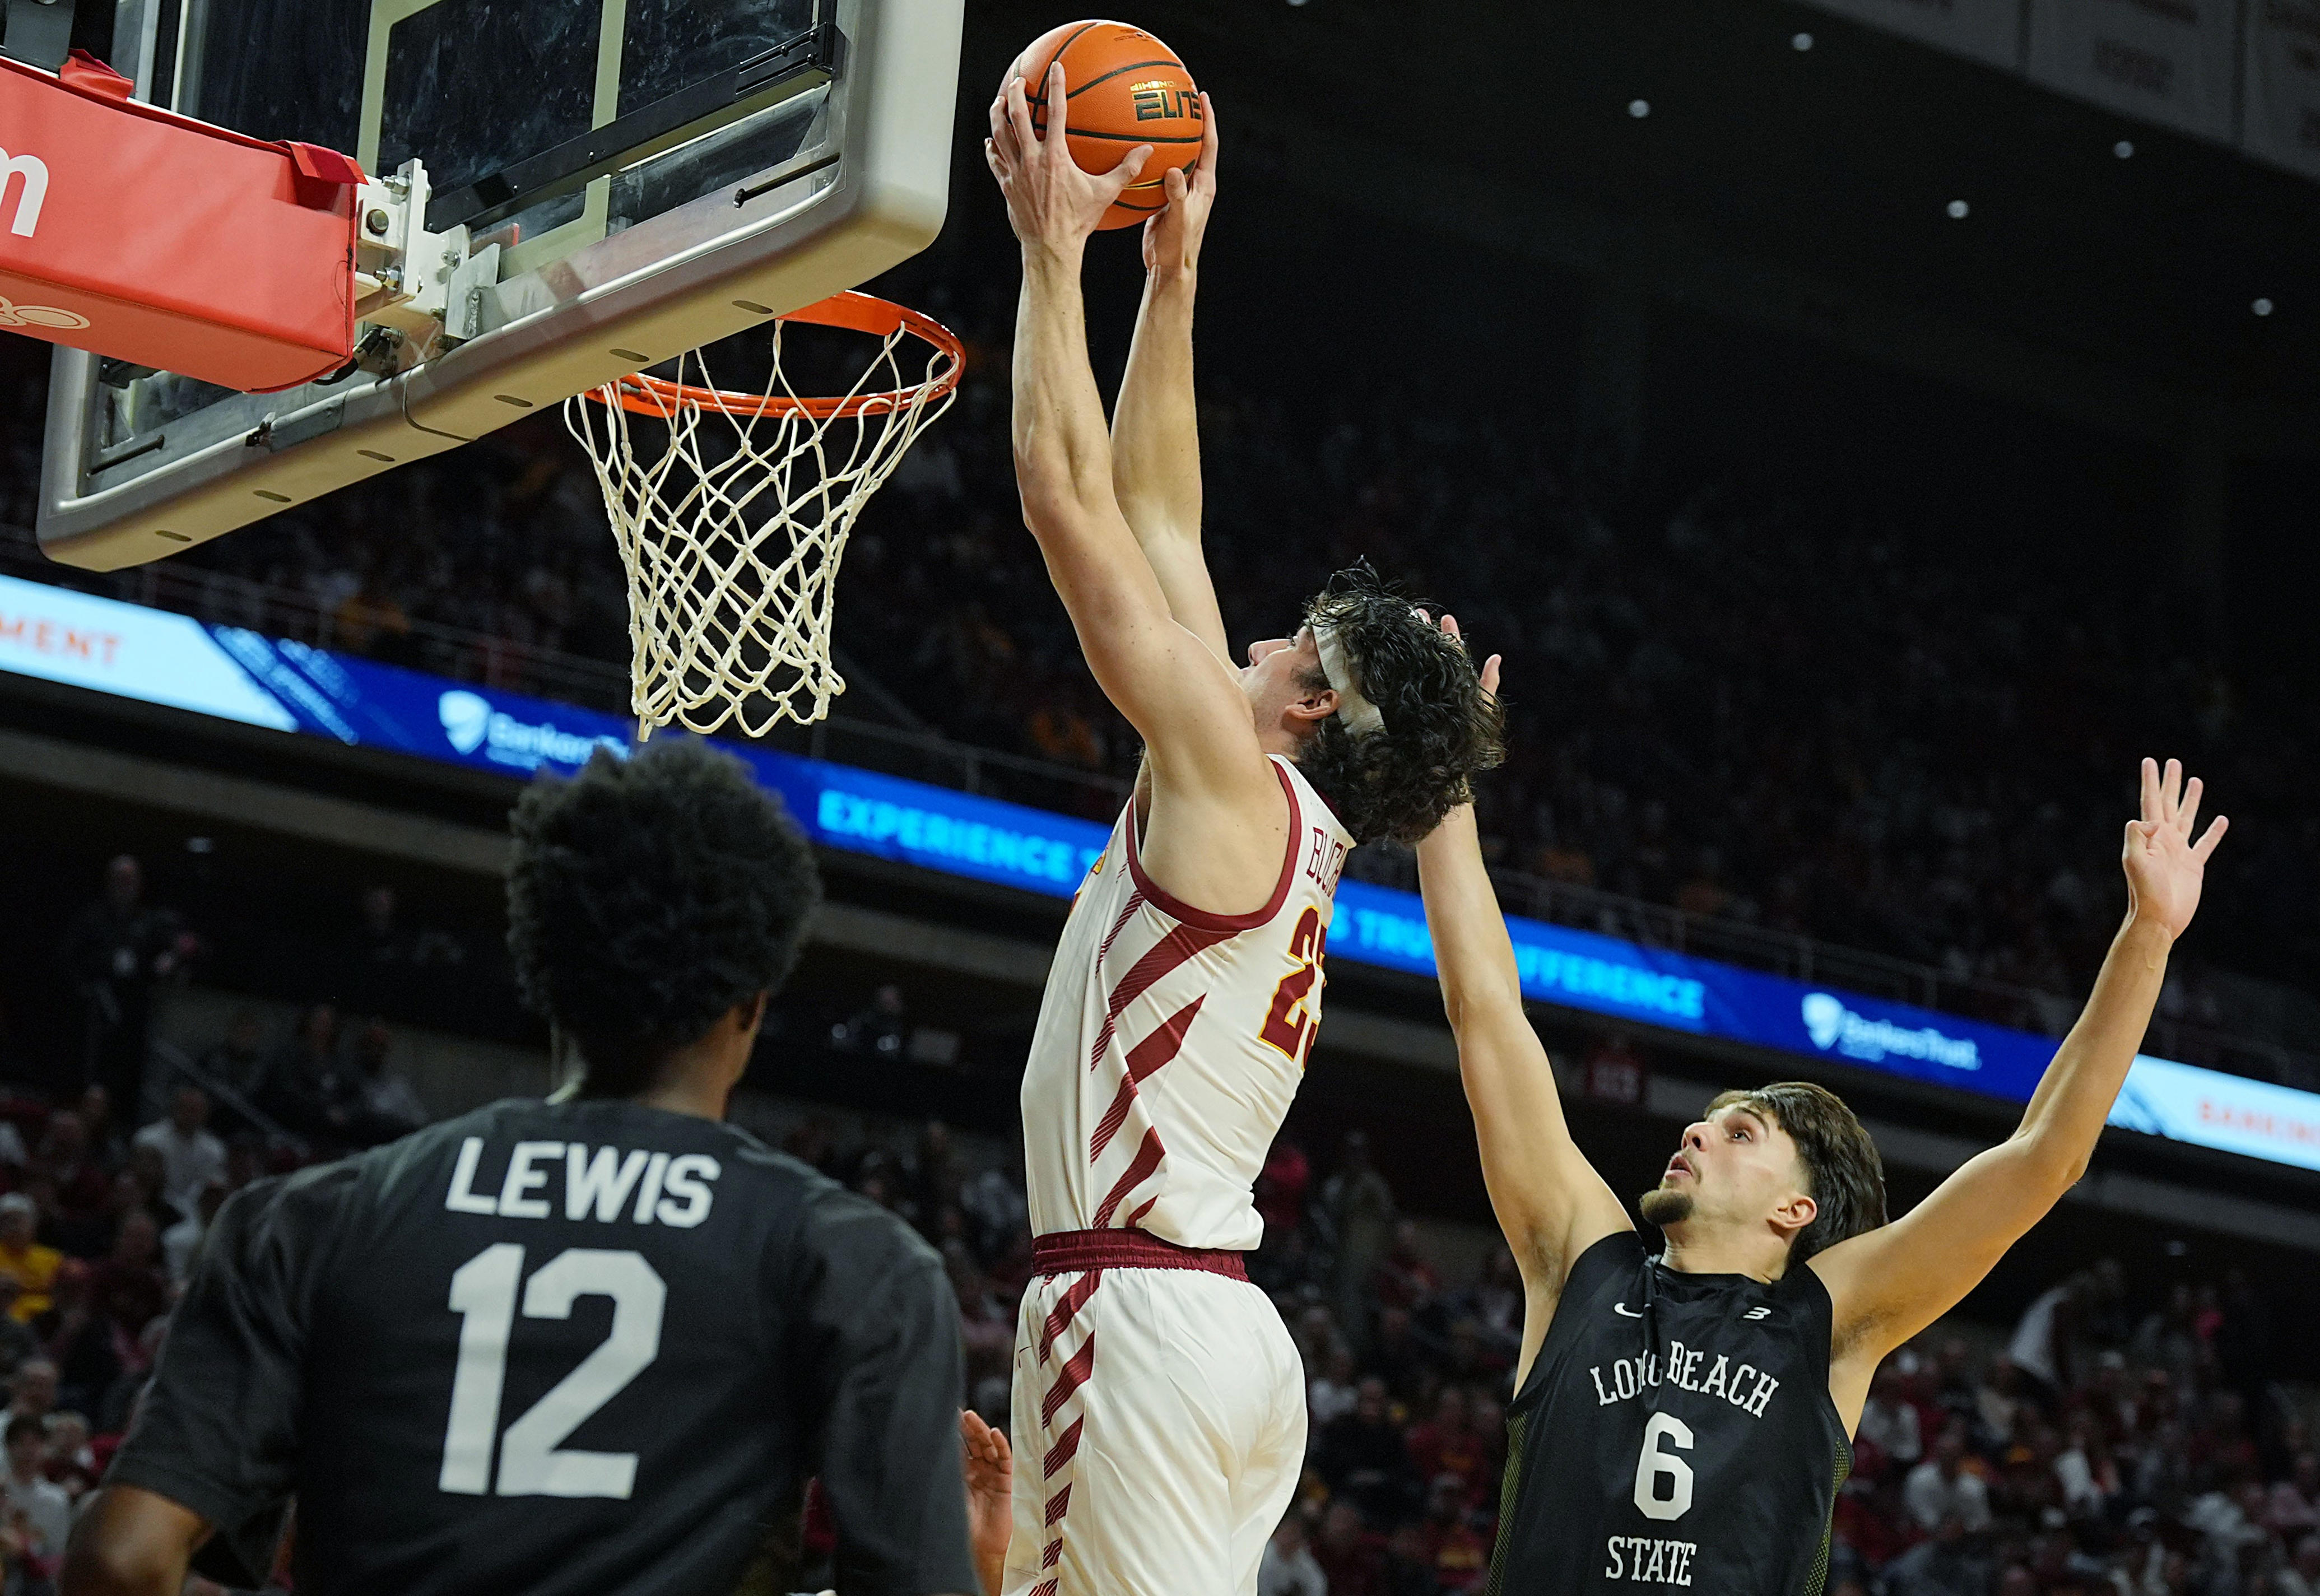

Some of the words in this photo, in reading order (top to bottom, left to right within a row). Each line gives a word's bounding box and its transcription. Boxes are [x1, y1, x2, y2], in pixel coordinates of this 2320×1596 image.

[1133, 90, 1202, 121] ELITE
[819, 790, 1073, 883] EXPERIENCE
[1514, 942, 1704, 1020] FFERENCE
[445, 1136, 722, 1229] LEWIS
[439, 1242, 667, 1500] 12
[1666, 1340, 1779, 1418] BEACH
[1634, 1411, 1694, 1521] 6
[1606, 1535, 1696, 1586] STATE
